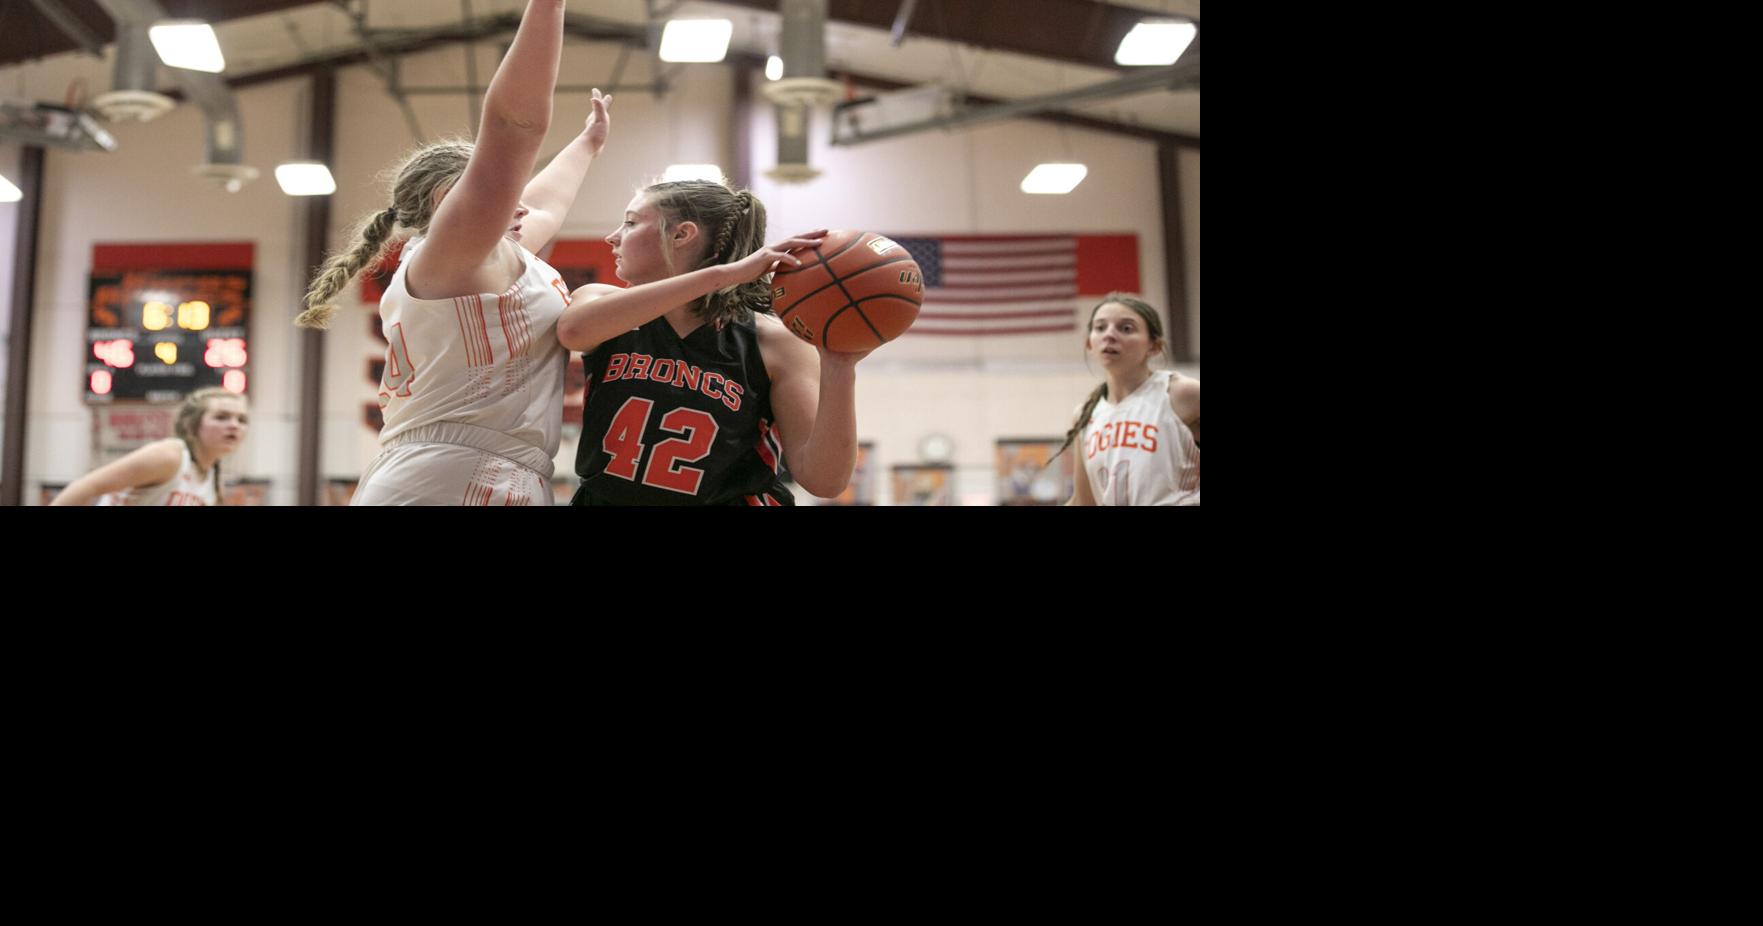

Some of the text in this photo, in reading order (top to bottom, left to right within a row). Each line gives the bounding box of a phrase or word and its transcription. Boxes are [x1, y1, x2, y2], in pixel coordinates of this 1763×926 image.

[602, 352, 745, 412] BRONCS
[602, 395, 720, 496] 42
[1085, 420, 1159, 459] OGIES
